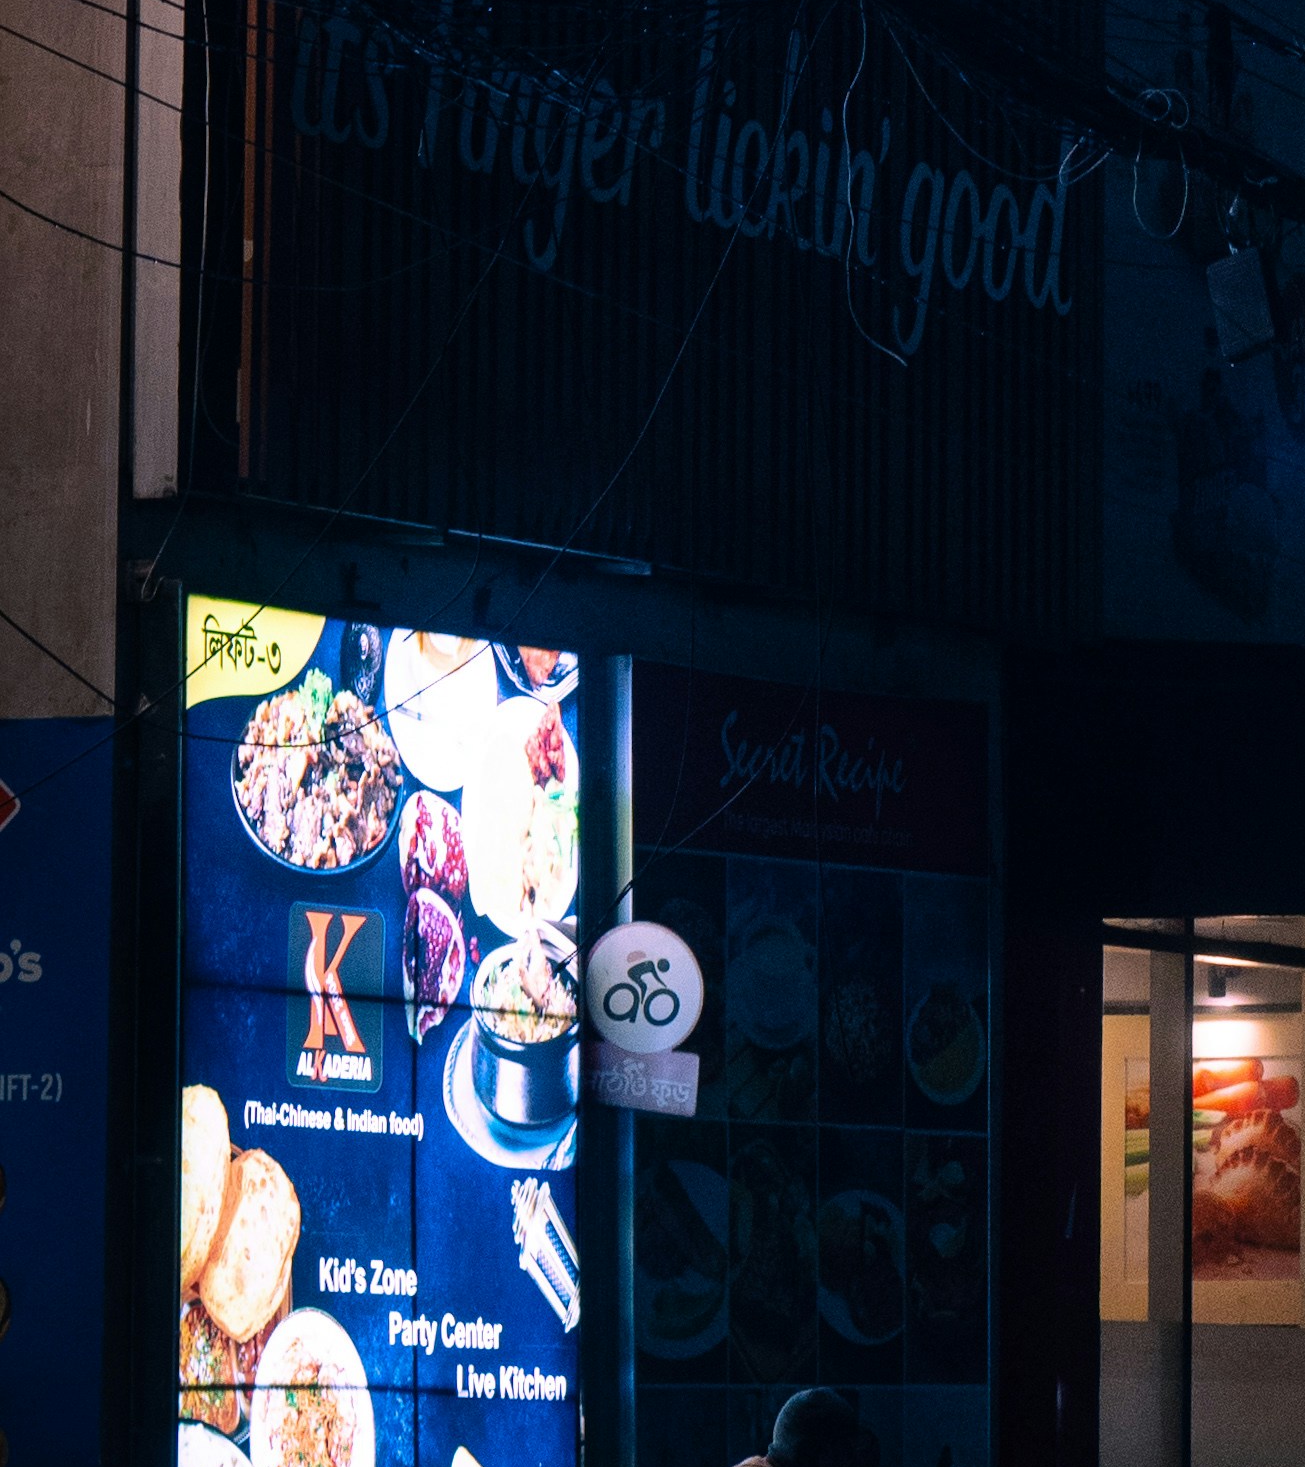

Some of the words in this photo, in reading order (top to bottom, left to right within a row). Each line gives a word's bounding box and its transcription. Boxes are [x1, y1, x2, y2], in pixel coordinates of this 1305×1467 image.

[892, 114, 1074, 357] good
[719, 709, 808, 789] Secret
[818, 723, 908, 821] Recipe
[244, 1100, 331, 1130] (Thai-Chinese
[333, 1108, 345, 1131] &
[347, 1109, 387, 1134] Indian
[389, 1112, 424, 1142] food)
[318, 1255, 367, 1296] Kid's
[369, 1259, 418, 1297] Zone
[389, 1312, 438, 1355] Party
[440, 1312, 503, 1350] Center
[456, 1364, 496, 1399] Live
[498, 1366, 567, 1402] Kitchen
